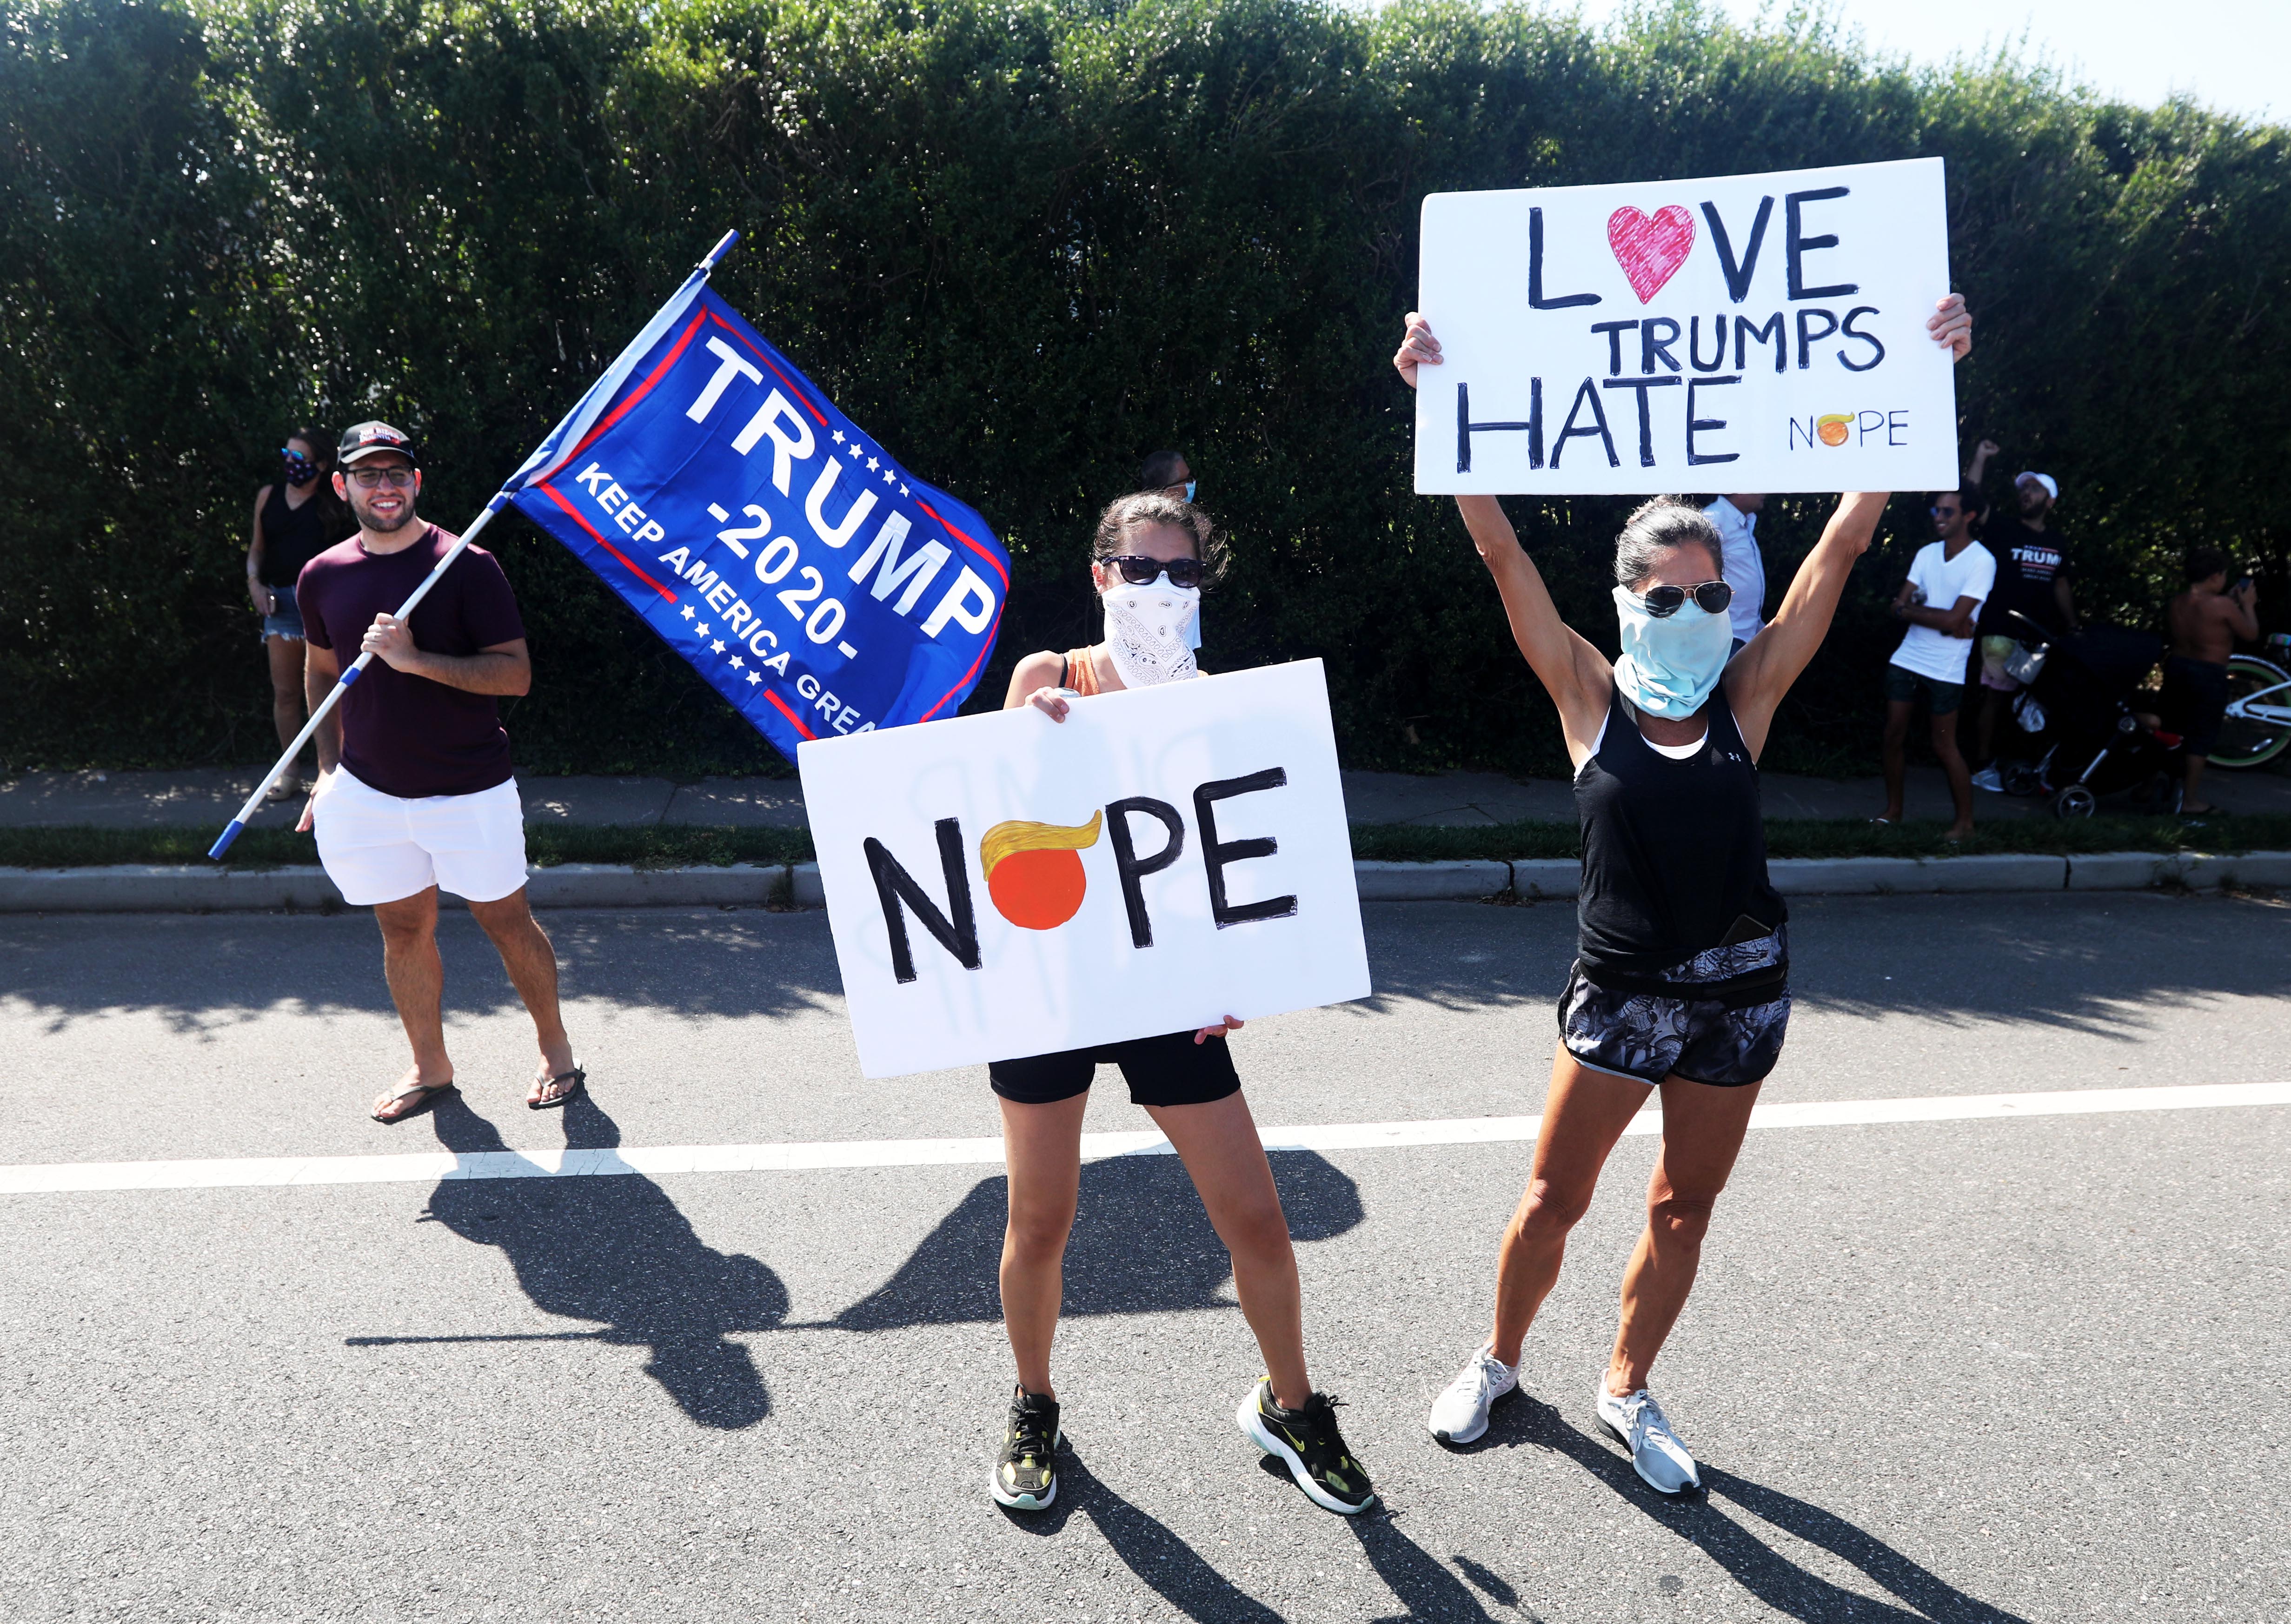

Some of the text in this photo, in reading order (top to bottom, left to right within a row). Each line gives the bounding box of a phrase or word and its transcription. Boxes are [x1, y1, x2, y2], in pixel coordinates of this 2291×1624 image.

[1591, 306, 1885, 376] TRUMPS
[1457, 375, 1742, 474] HATE
[685, 336, 996, 639] TRUMP
[575, 462, 665, 542] KEEP
[657, 546, 790, 677] AMERICA
[2011, 548, 2062, 567] TRUM
